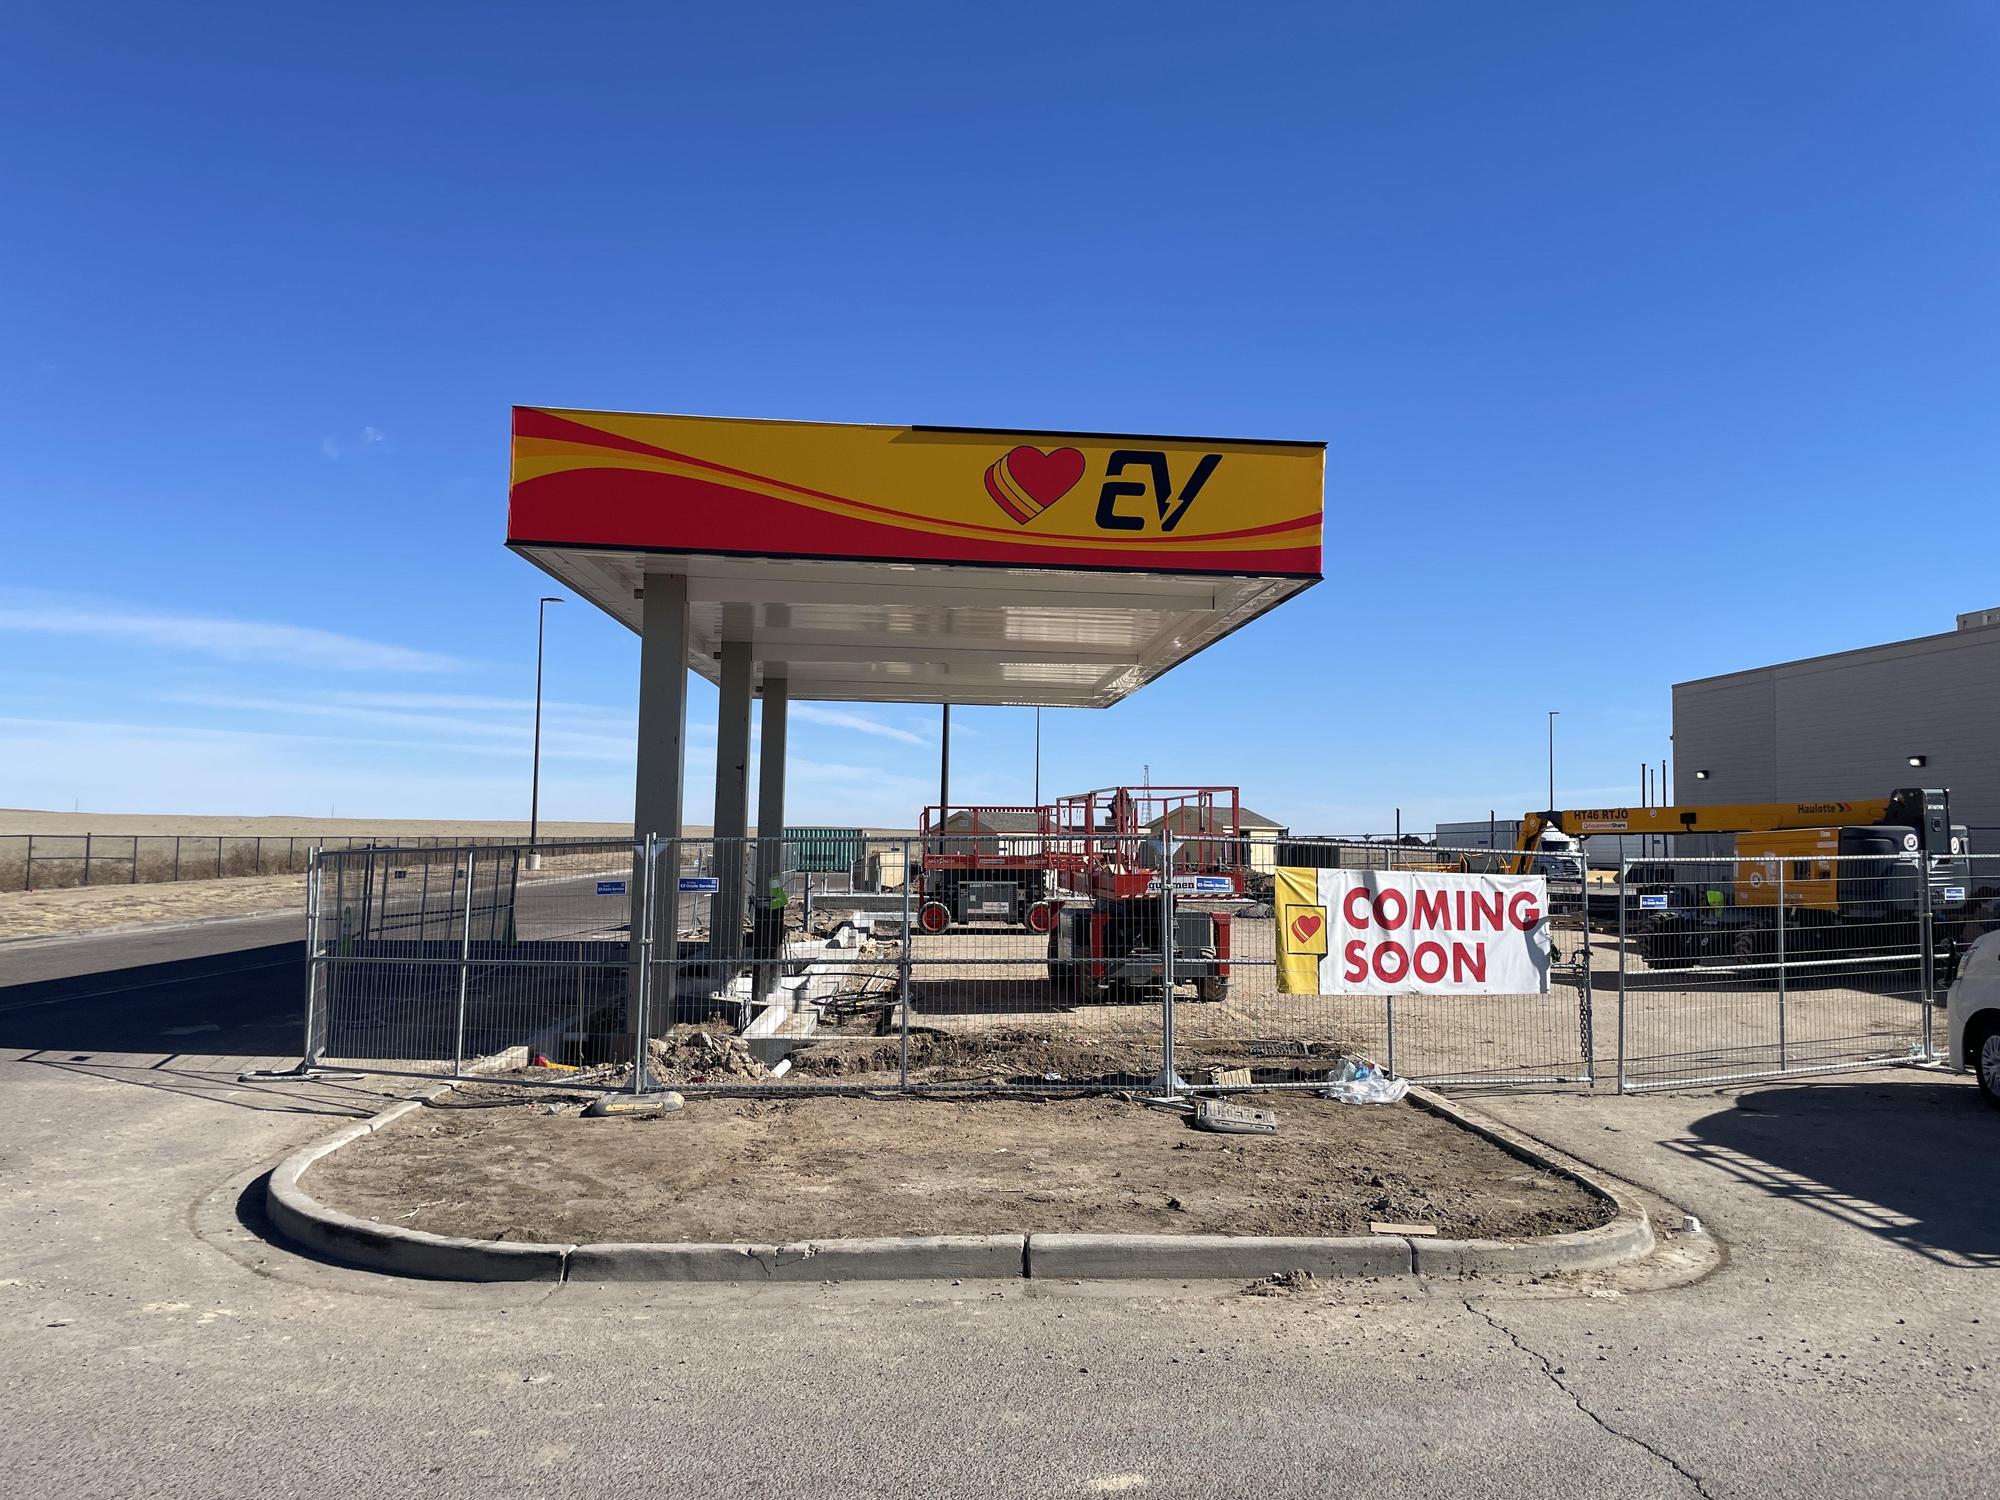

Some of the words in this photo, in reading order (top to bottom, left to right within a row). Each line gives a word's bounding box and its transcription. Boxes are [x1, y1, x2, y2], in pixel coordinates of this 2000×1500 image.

[1094, 449, 1223, 532] EV
[1574, 810, 1599, 820] HT46
[1602, 809, 1628, 820] RTJO
[1798, 803, 1836, 813] Haulotte
[1343, 887, 1541, 932] COMING
[1344, 939, 1486, 984] SOON
